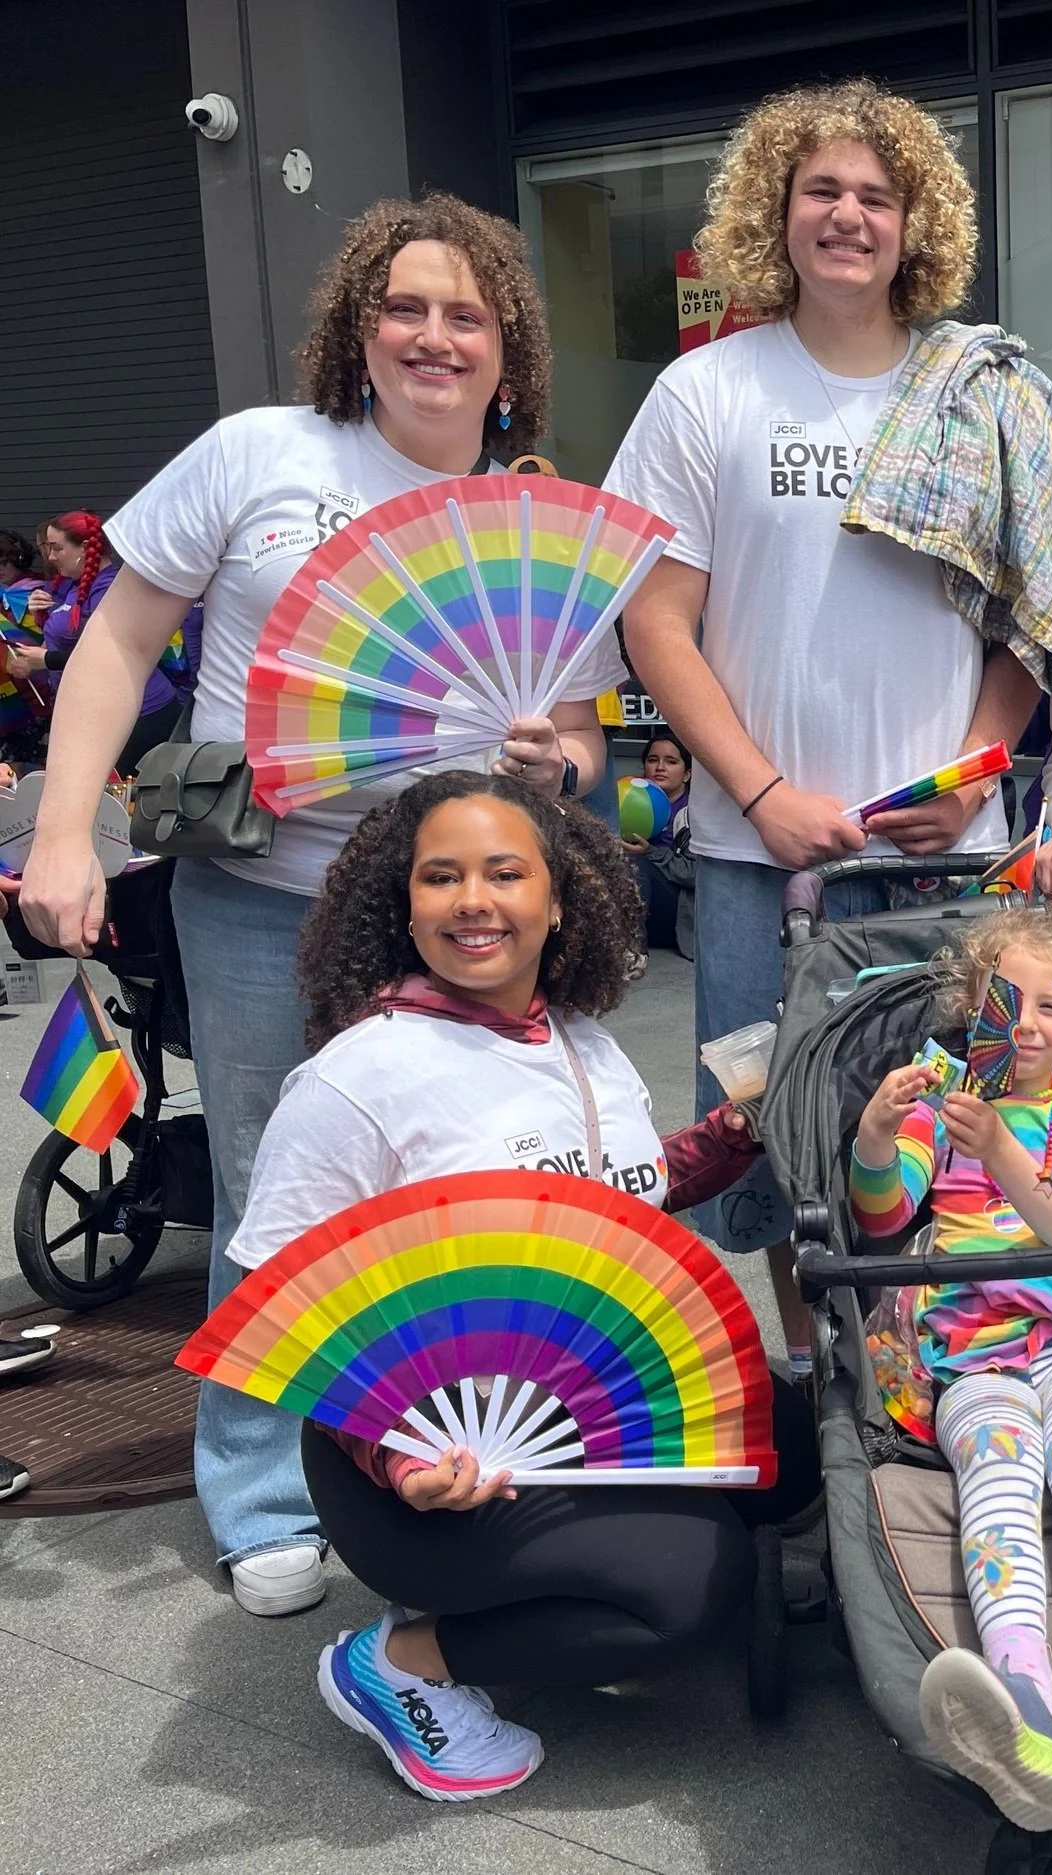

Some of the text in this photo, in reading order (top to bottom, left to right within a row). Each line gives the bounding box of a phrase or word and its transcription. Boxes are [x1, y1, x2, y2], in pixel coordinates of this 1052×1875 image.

[683, 288, 721, 302] We Are
[681, 300, 724, 315] OPEN
[770, 442, 848, 470] LOVE
[771, 470, 806, 497] BE
[278, 529, 302, 539] Nice
[255, 541, 287, 559] Jewish
[288, 535, 315, 546] Girls
[394, 1688, 450, 1757] HOKA
